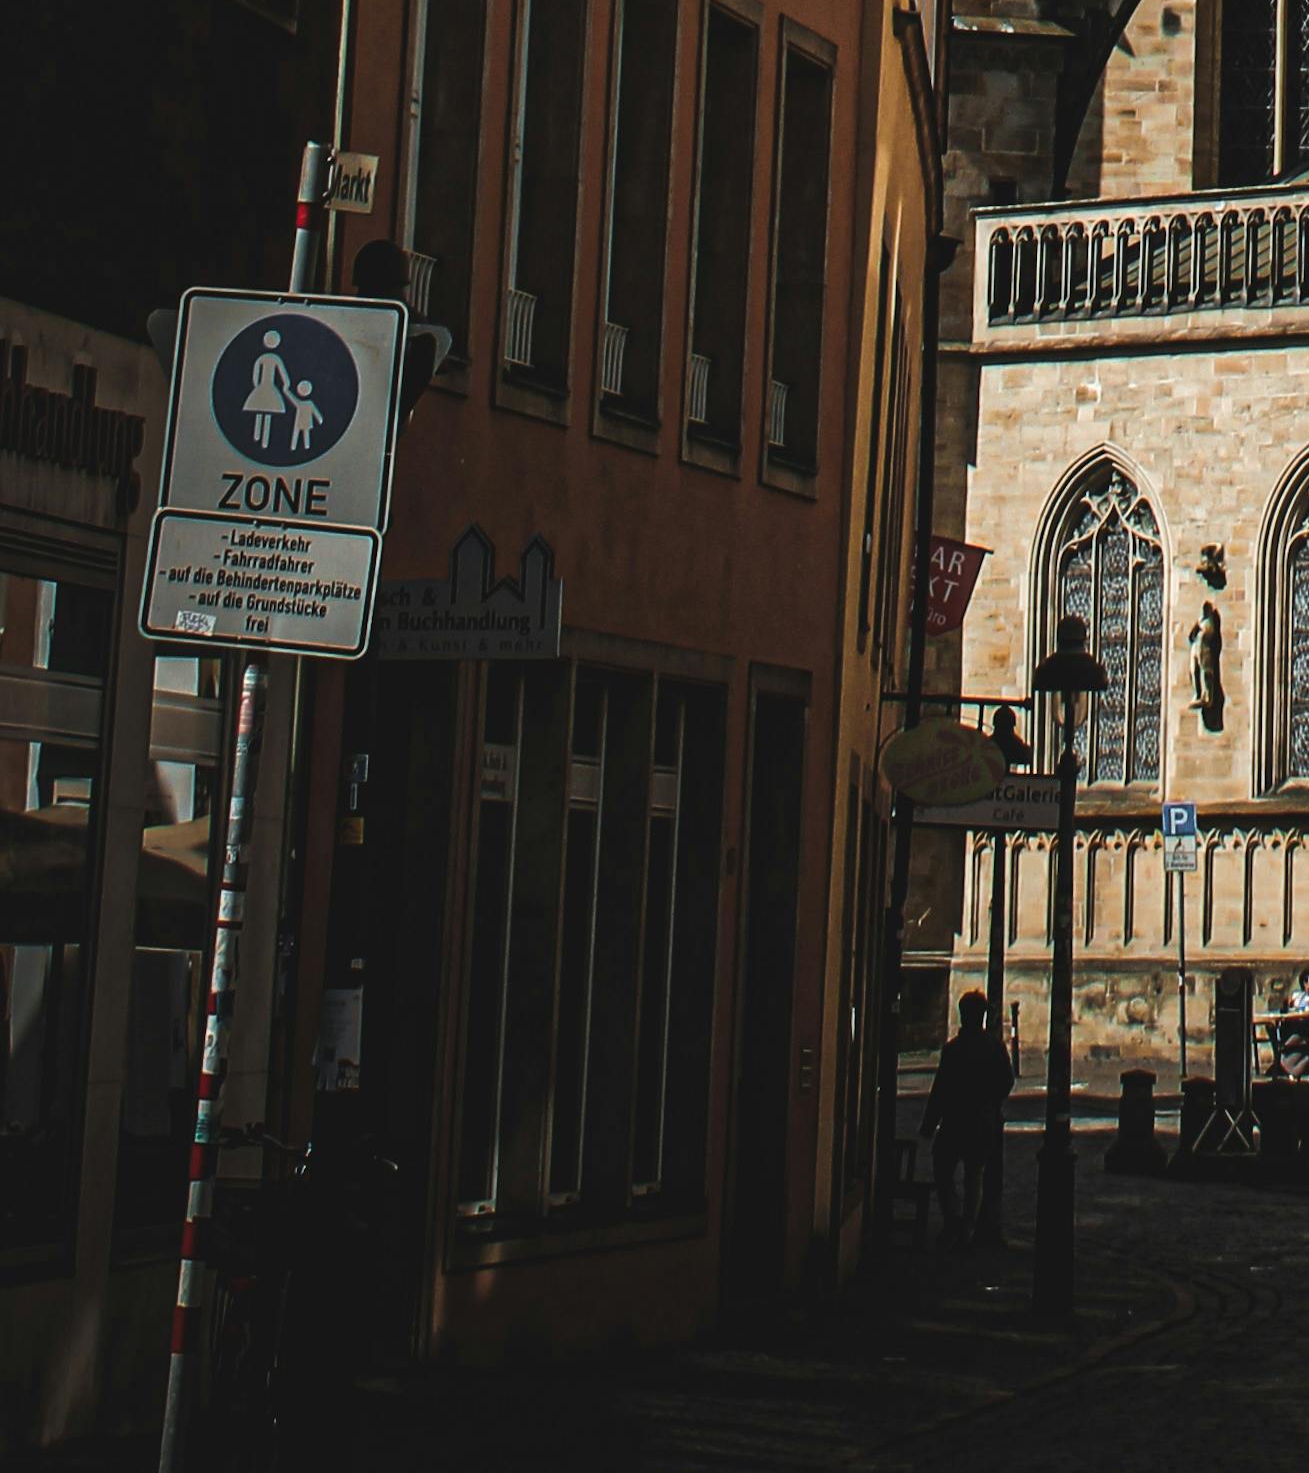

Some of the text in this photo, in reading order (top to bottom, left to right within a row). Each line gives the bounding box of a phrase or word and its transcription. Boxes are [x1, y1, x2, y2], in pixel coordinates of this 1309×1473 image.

[218, 473, 331, 516] ZONE
[230, 529, 312, 552] Ladeverkehr
[222, 549, 315, 574] Fahrradfahrer
[168, 566, 192, 582] auf
[193, 567, 214, 585] die
[216, 569, 362, 601] Behindertenparkplätze
[198, 591, 222, 607] auf
[223, 590, 244, 610] die
[246, 593, 328, 618] Grundstücke
[245, 615, 270, 634] frei
[398, 610, 532, 636] Buchhandlung
[1170, 807, 1189, 835] P
